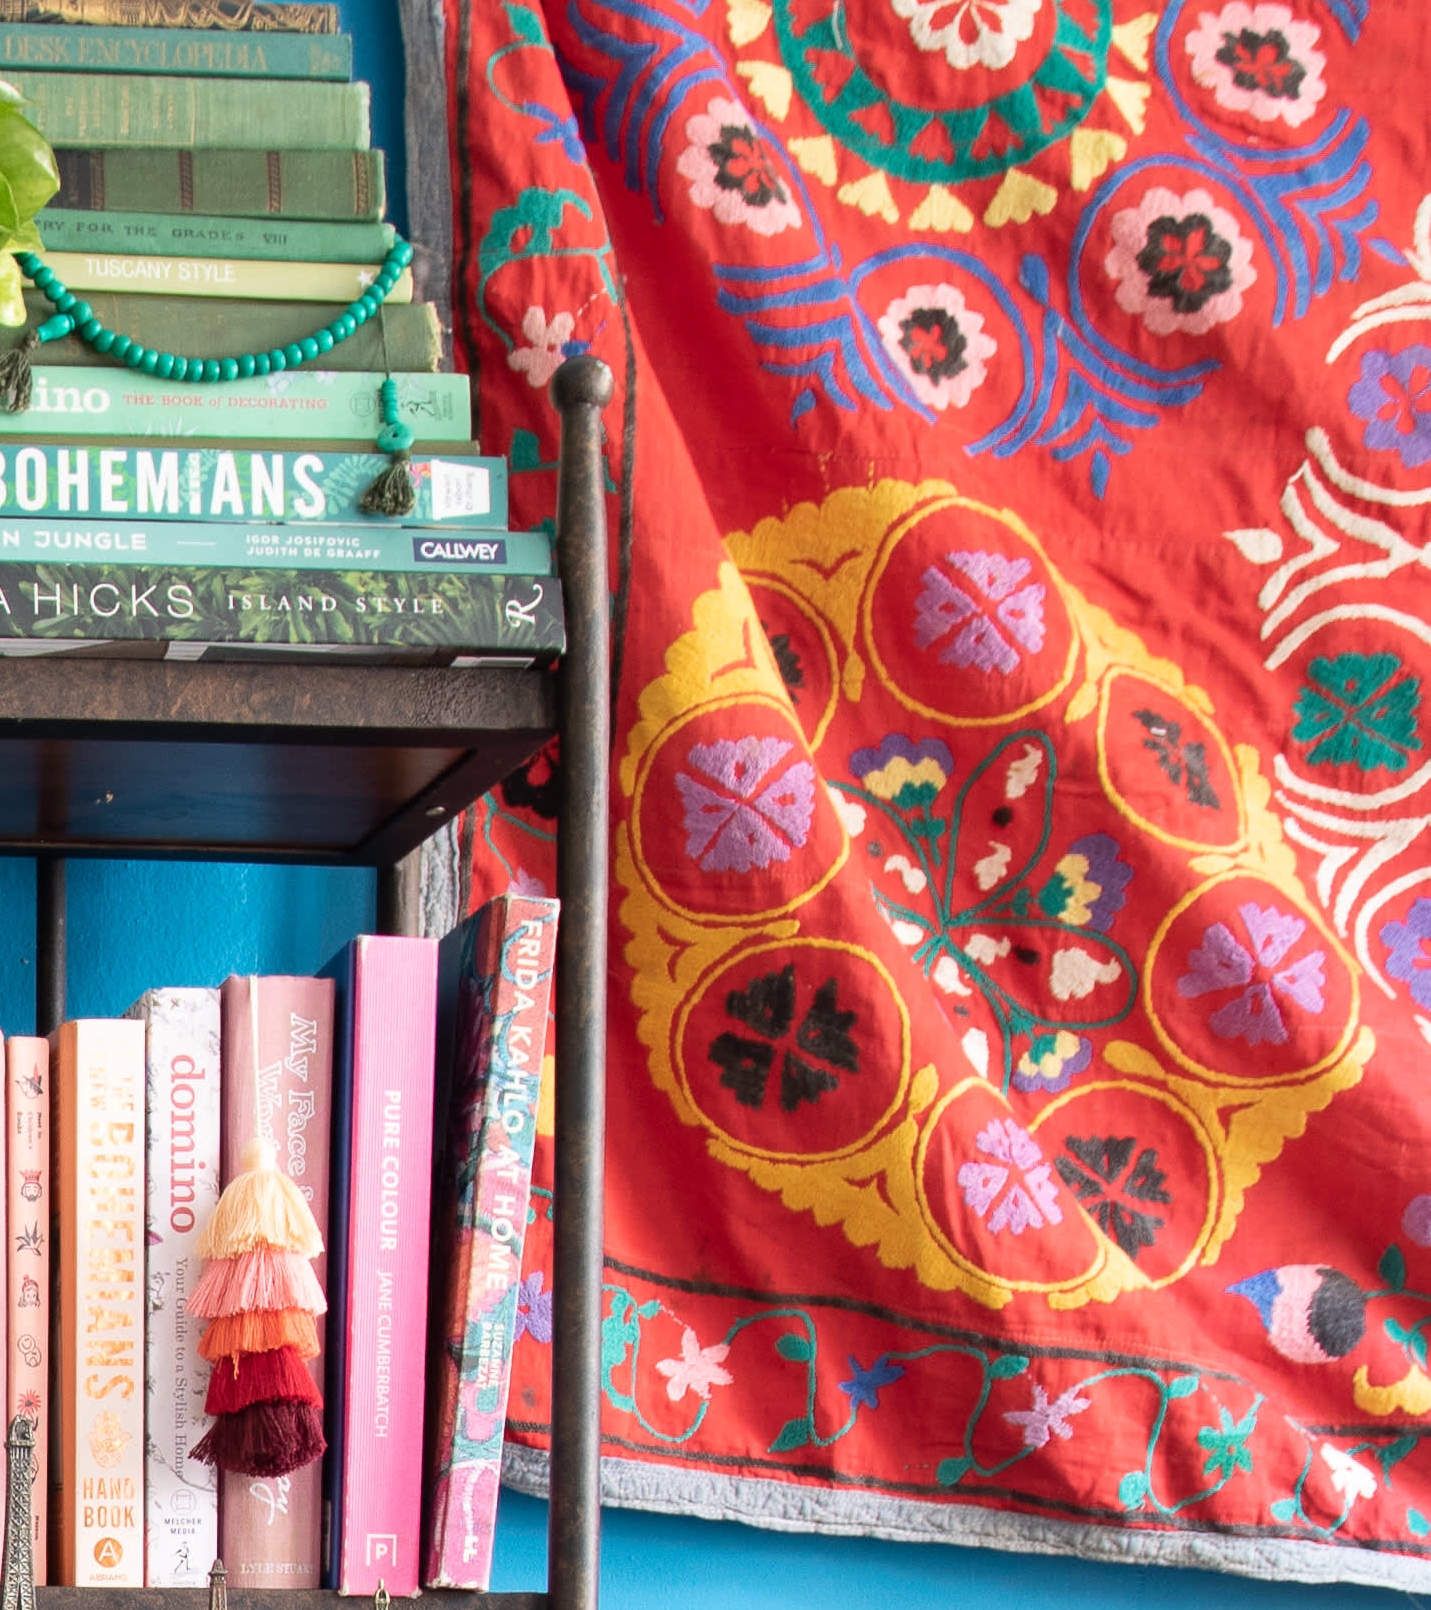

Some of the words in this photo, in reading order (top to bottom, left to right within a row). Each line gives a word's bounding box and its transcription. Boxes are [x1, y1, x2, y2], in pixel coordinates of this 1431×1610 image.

[84, 257, 173, 281] TUSCANY
[177, 262, 236, 283] STYLE
[34, 530, 148, 551] JUNGLE
[419, 541, 500, 561] CALLWEY
[33, 582, 195, 618] HICKS
[228, 594, 338, 612] ISLAND
[355, 595, 444, 614] STYLE
[513, 919, 541, 1012] FRIDA
[287, 1013, 317, 1082] My
[501, 1025, 532, 1134] KAHLO
[170, 1053, 207, 1234] domino
[288, 1089, 315, 1177] Face
[383, 1090, 402, 1148] PURE
[495, 1144, 520, 1184] AT
[380, 1155, 399, 1250] COLOUR
[85, 1120, 136, 1400] BOHEMIANS
[486, 1195, 516, 1290] HOME
[376, 1270, 393, 1310] JANE
[374, 1313, 393, 1438] CUMBERBATCH
[475, 1322, 492, 1389] BARBEZAT
[488, 1322, 505, 1388] SUZANNE
[83, 1477, 135, 1500] HAND
[83, 1505, 135, 1528] BOOK
